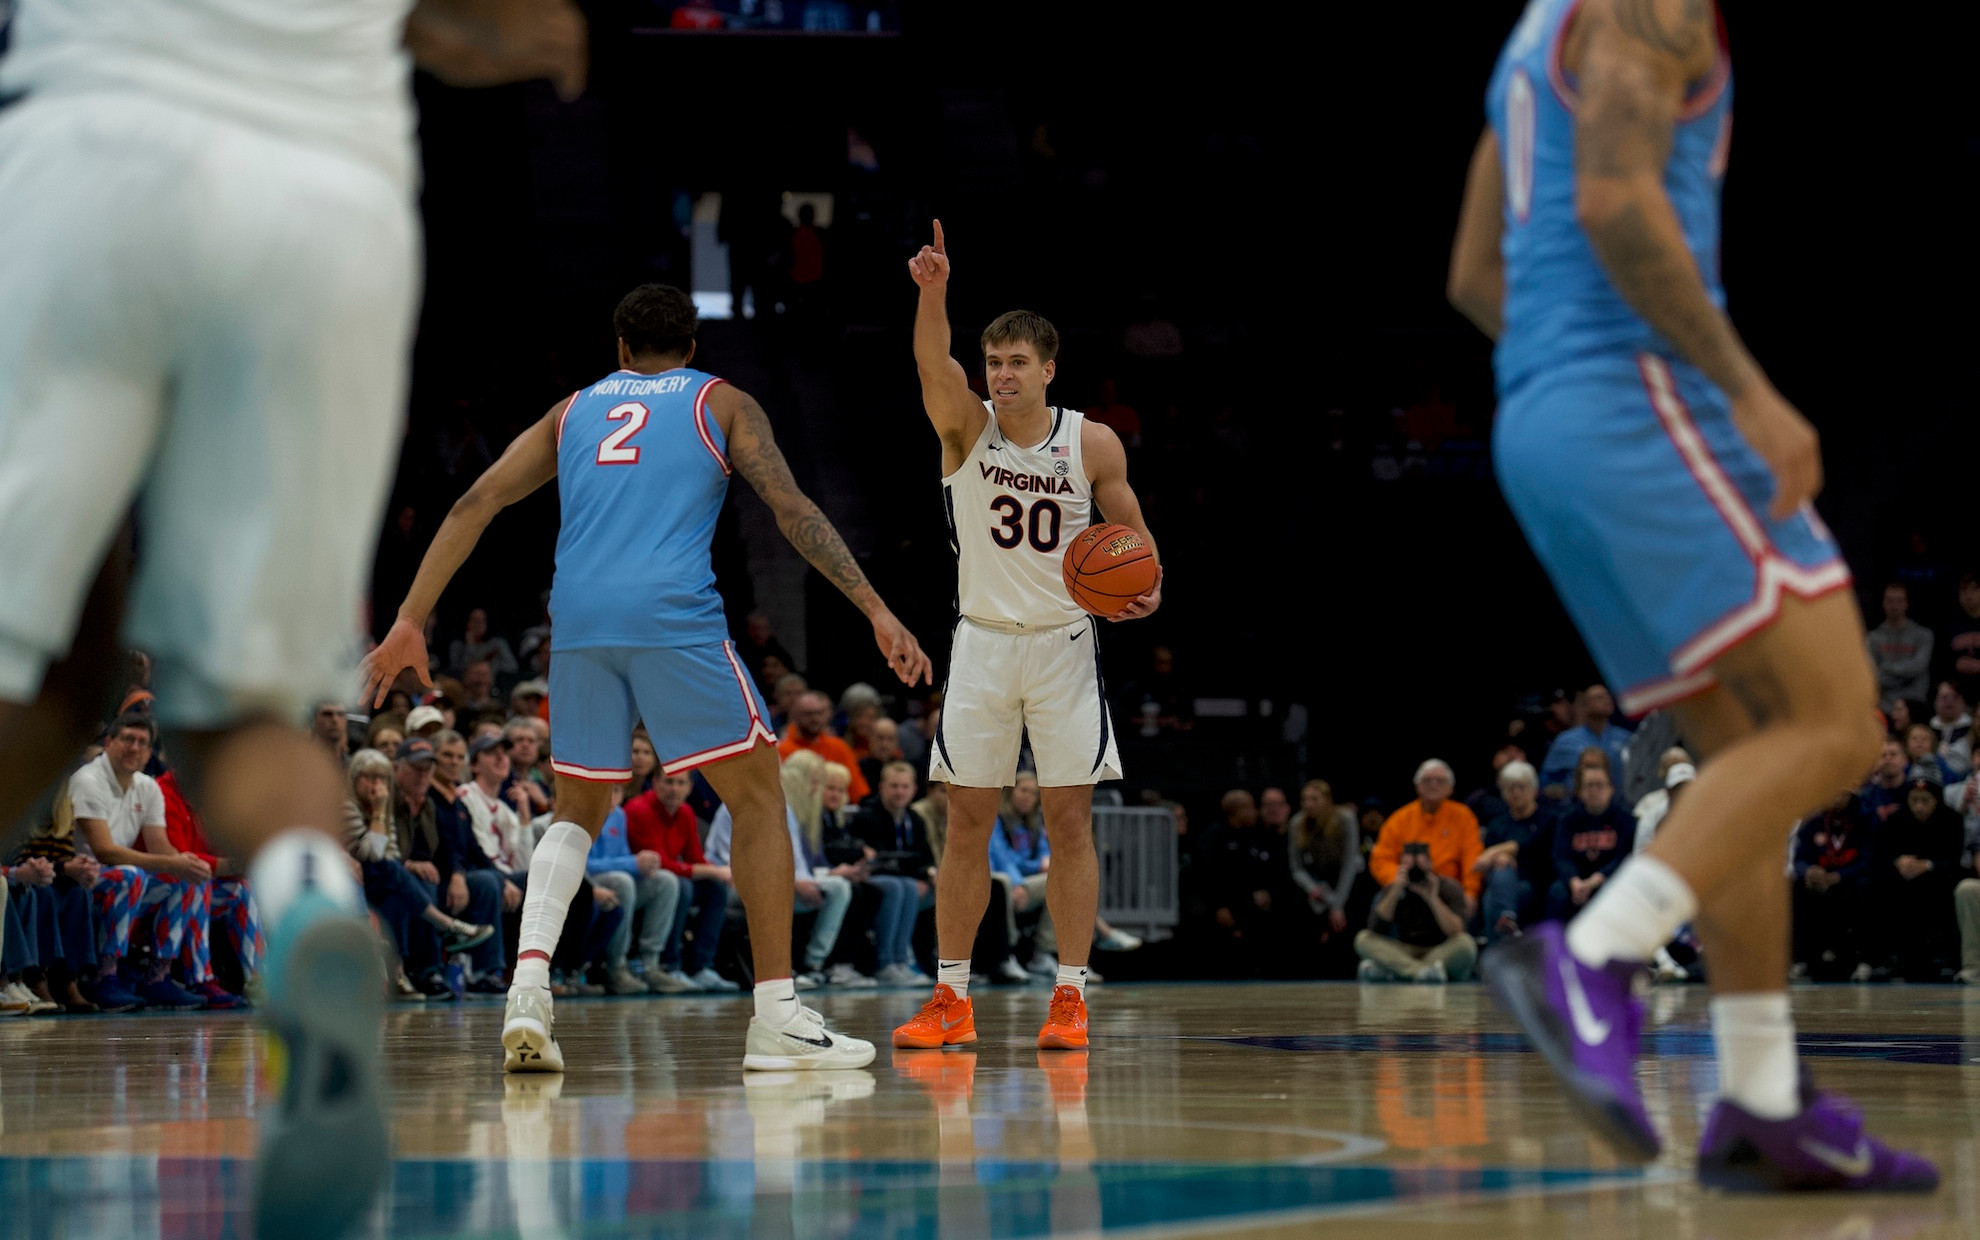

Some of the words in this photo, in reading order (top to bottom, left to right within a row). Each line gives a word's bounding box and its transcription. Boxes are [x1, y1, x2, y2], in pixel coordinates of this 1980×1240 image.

[589, 375, 692, 397] MONTGOMERY
[596, 401, 650, 465] 2
[978, 461, 1075, 495] VIRGINIA
[990, 495, 1062, 553] 30
